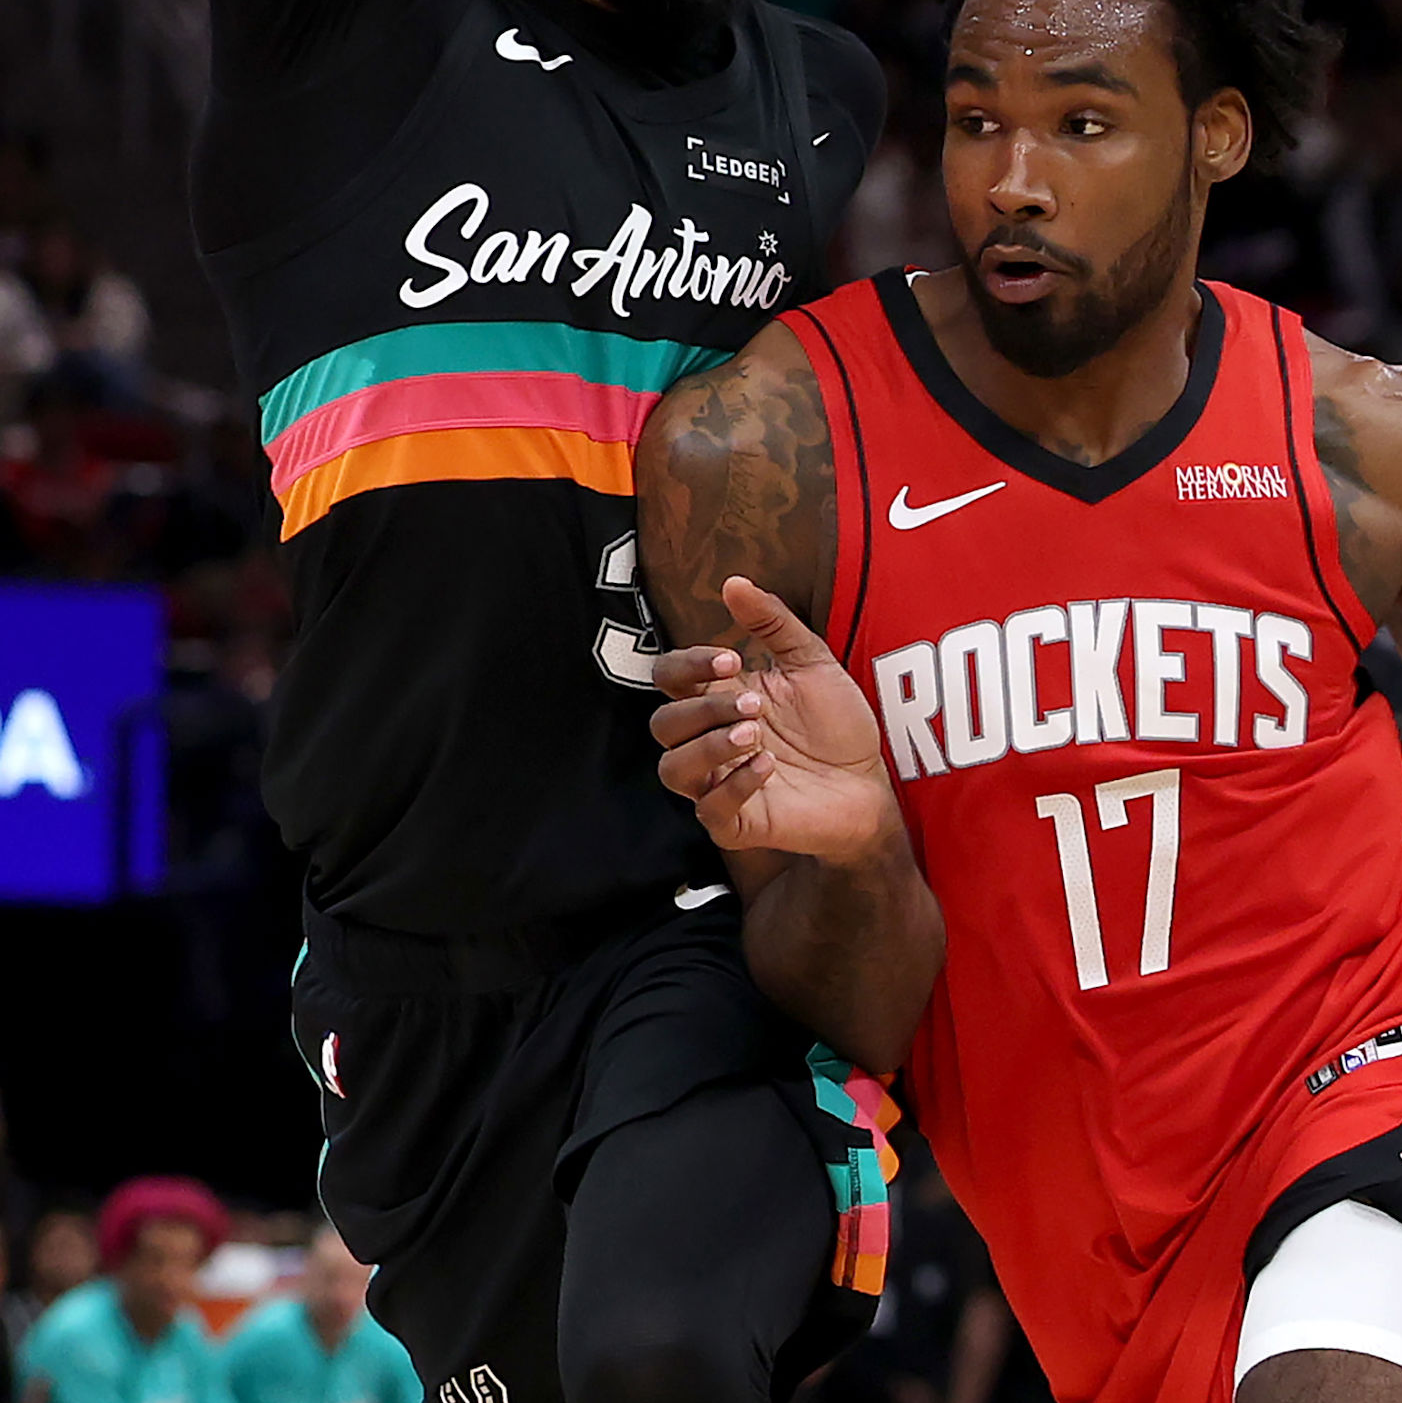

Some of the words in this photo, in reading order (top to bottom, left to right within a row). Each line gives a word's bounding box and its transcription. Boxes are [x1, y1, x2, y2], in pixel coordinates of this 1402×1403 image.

[701, 150, 780, 189] LEDGER
[400, 182, 570, 308] San
[571, 202, 792, 317] Antonio
[1175, 462, 1286, 484] MEMORIAL
[1177, 481, 1288, 500] HERMANN
[872, 597, 1312, 781] ROCKETS
[1036, 768, 1181, 992] 17
